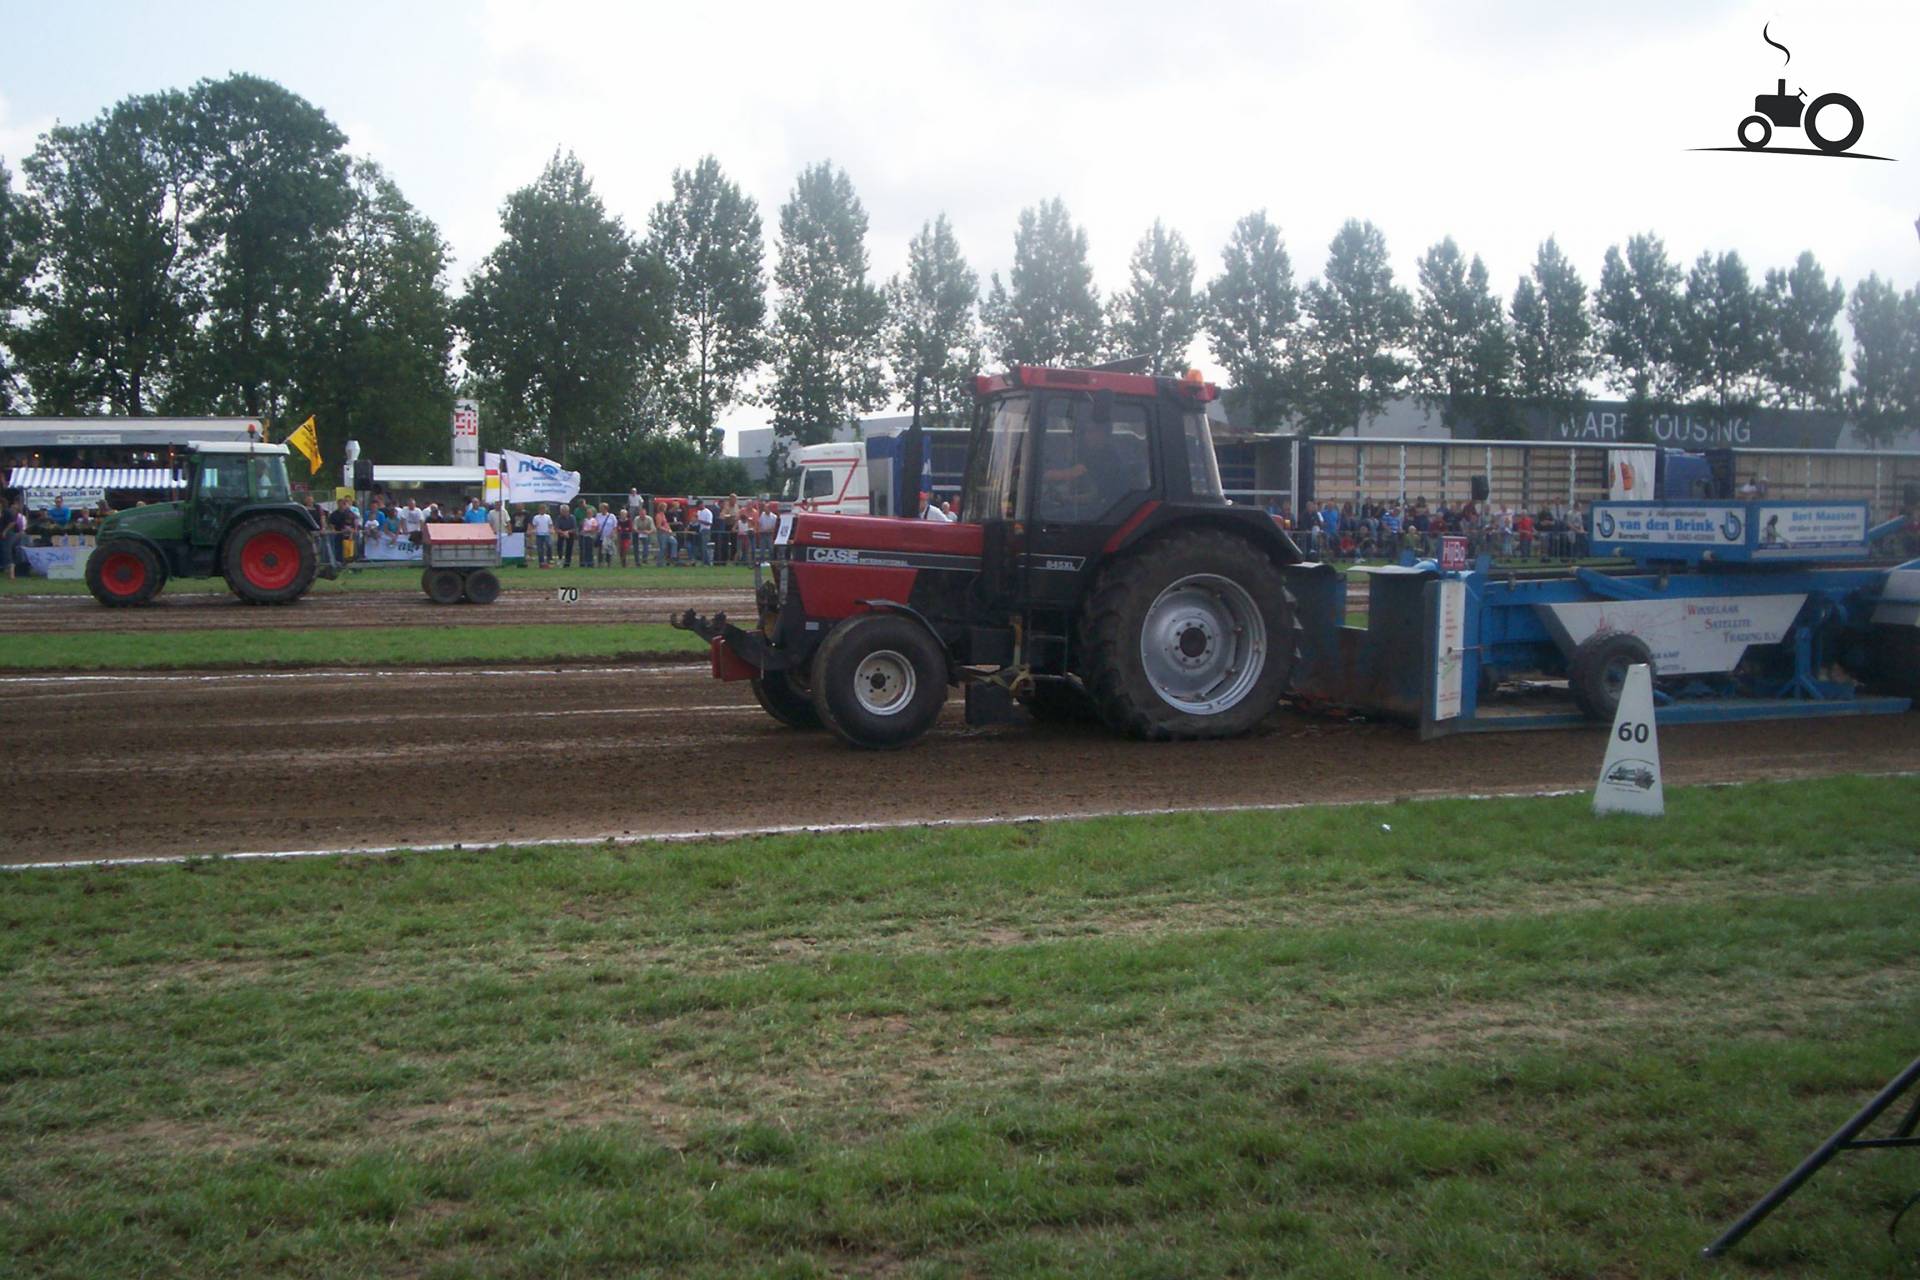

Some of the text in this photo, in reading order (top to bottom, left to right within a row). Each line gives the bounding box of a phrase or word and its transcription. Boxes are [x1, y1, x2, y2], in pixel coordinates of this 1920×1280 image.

[1618, 518, 1715, 532] van den Brink
[813, 548, 859, 563] CASE
[560, 587, 579, 601] 70
[1618, 721, 1650, 743] 60
